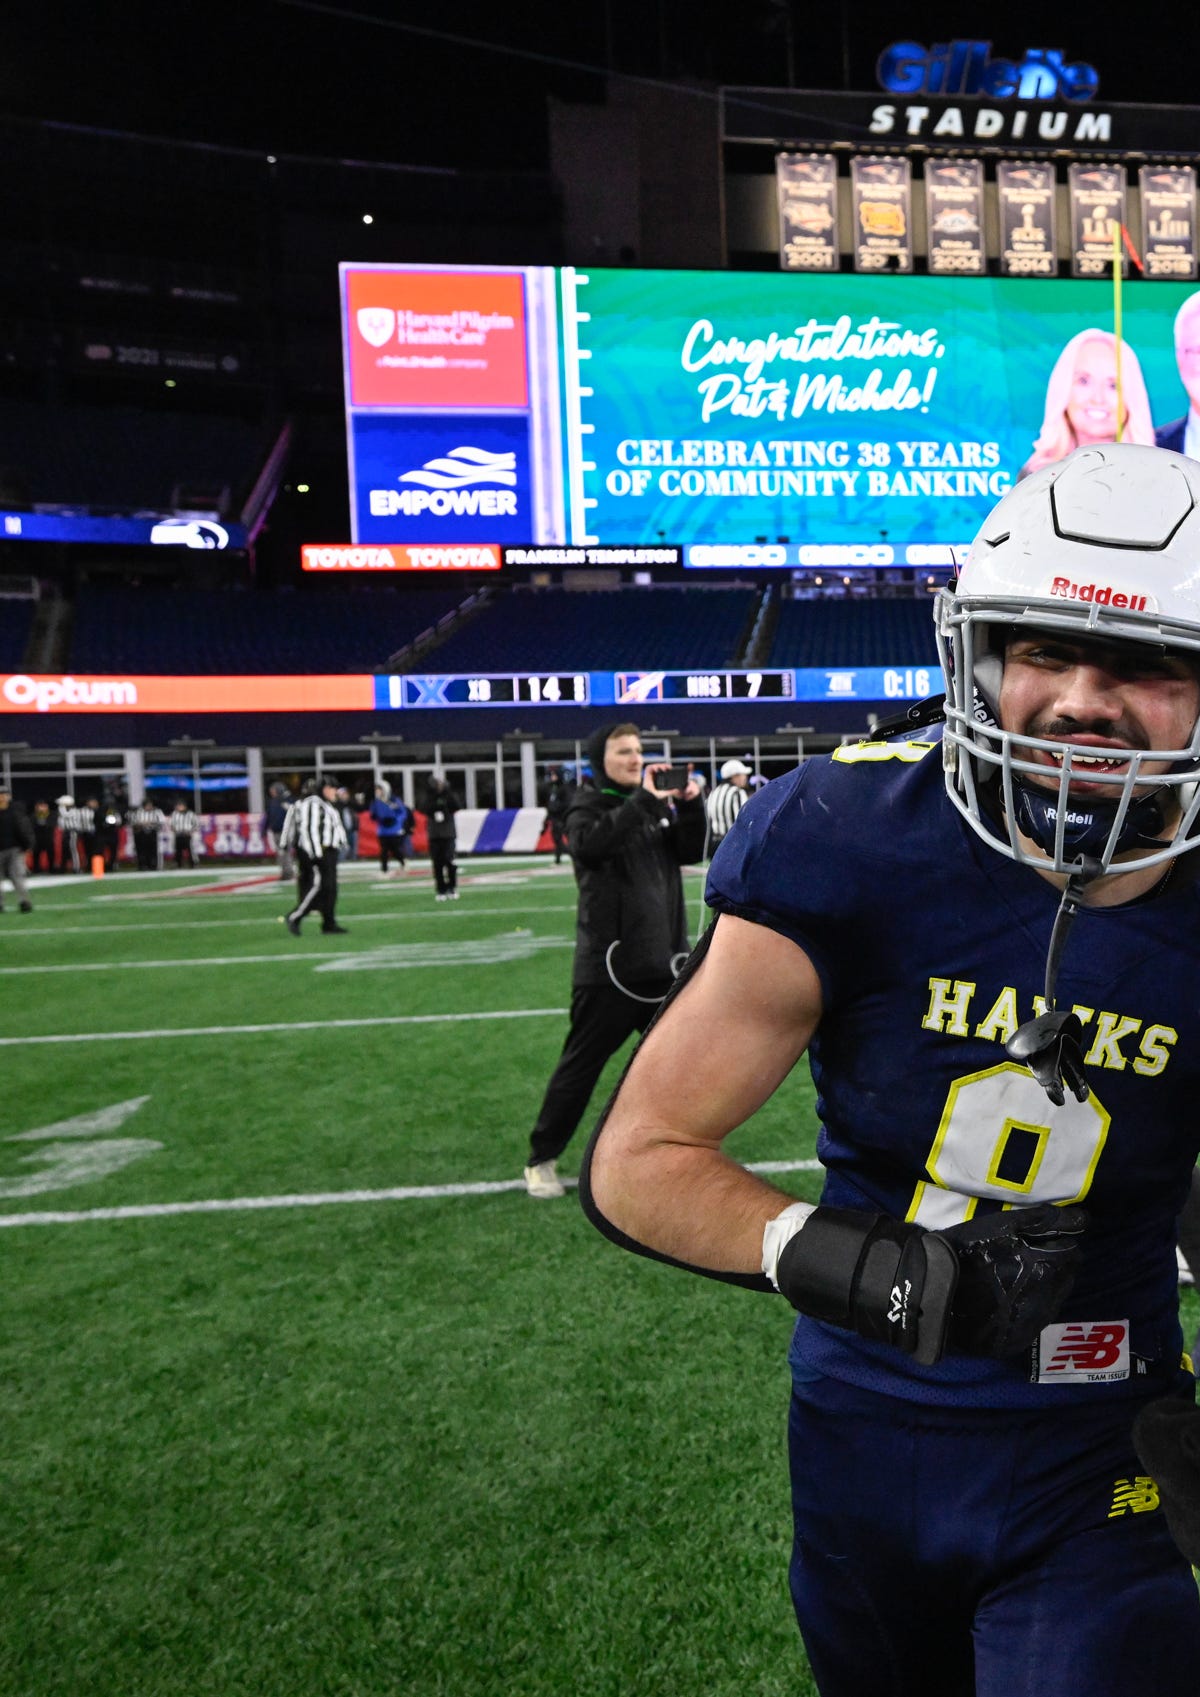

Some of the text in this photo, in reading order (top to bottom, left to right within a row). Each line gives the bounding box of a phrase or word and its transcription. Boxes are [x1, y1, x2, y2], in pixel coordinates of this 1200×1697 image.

[868, 104, 1112, 142] STADIUM
[788, 252, 833, 267] 2001
[935, 256, 980, 270] 2004
[1008, 257, 1051, 273] 2014
[681, 315, 945, 381] Congratulations,
[616, 439, 1001, 467] CELEBRATING 38 YEARS
[606, 471, 1012, 497] OF COMMUNITY BANKING
[370, 490, 517, 516] EMPOWER
[304, 548, 496, 567] TOYOTA TOYOTA
[506, 550, 678, 565] FRANKLIN TEMPLETON
[1050, 576, 1148, 612] Riddell
[3, 675, 137, 712] Optum
[528, 676, 561, 702] 14
[746, 673, 762, 697] 7
[884, 669, 930, 697] 0:16
[1047, 807, 1093, 825] Rddell
[1087, 1372, 1127, 1382] TEAM ISSUE
[1136, 1359, 1147, 1375] M
